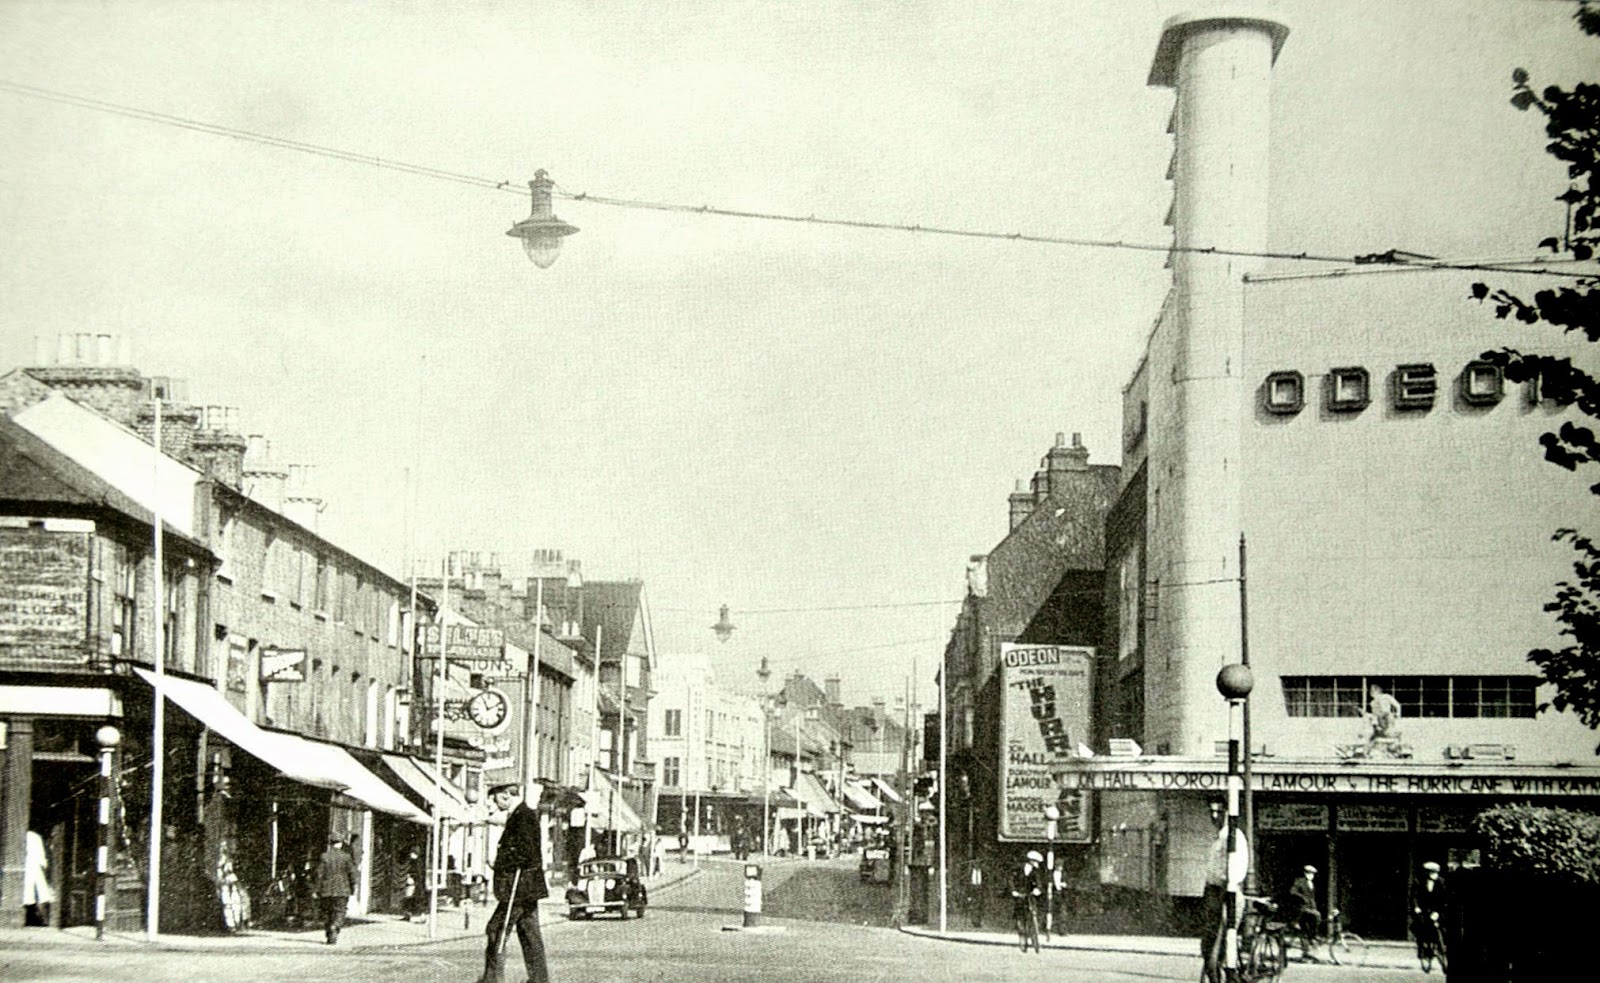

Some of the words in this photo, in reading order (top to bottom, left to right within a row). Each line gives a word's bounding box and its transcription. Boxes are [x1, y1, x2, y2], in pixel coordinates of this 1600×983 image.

[1256, 362, 1560, 420] ODEO
[1006, 648, 1058, 666] ODEON
[1010, 677, 1045, 690] THE
[1010, 753, 1048, 765] HALL
[1007, 777, 1051, 789] LAMOUR
[1103, 771, 1138, 789] HALL
[1162, 772, 1246, 790] DOROT
[1261, 774, 1336, 791] LAMOUR
[1368, 776, 1399, 792] THE
[1408, 776, 1502, 793] HURRICANE
[1512, 777, 1552, 794] WITH
